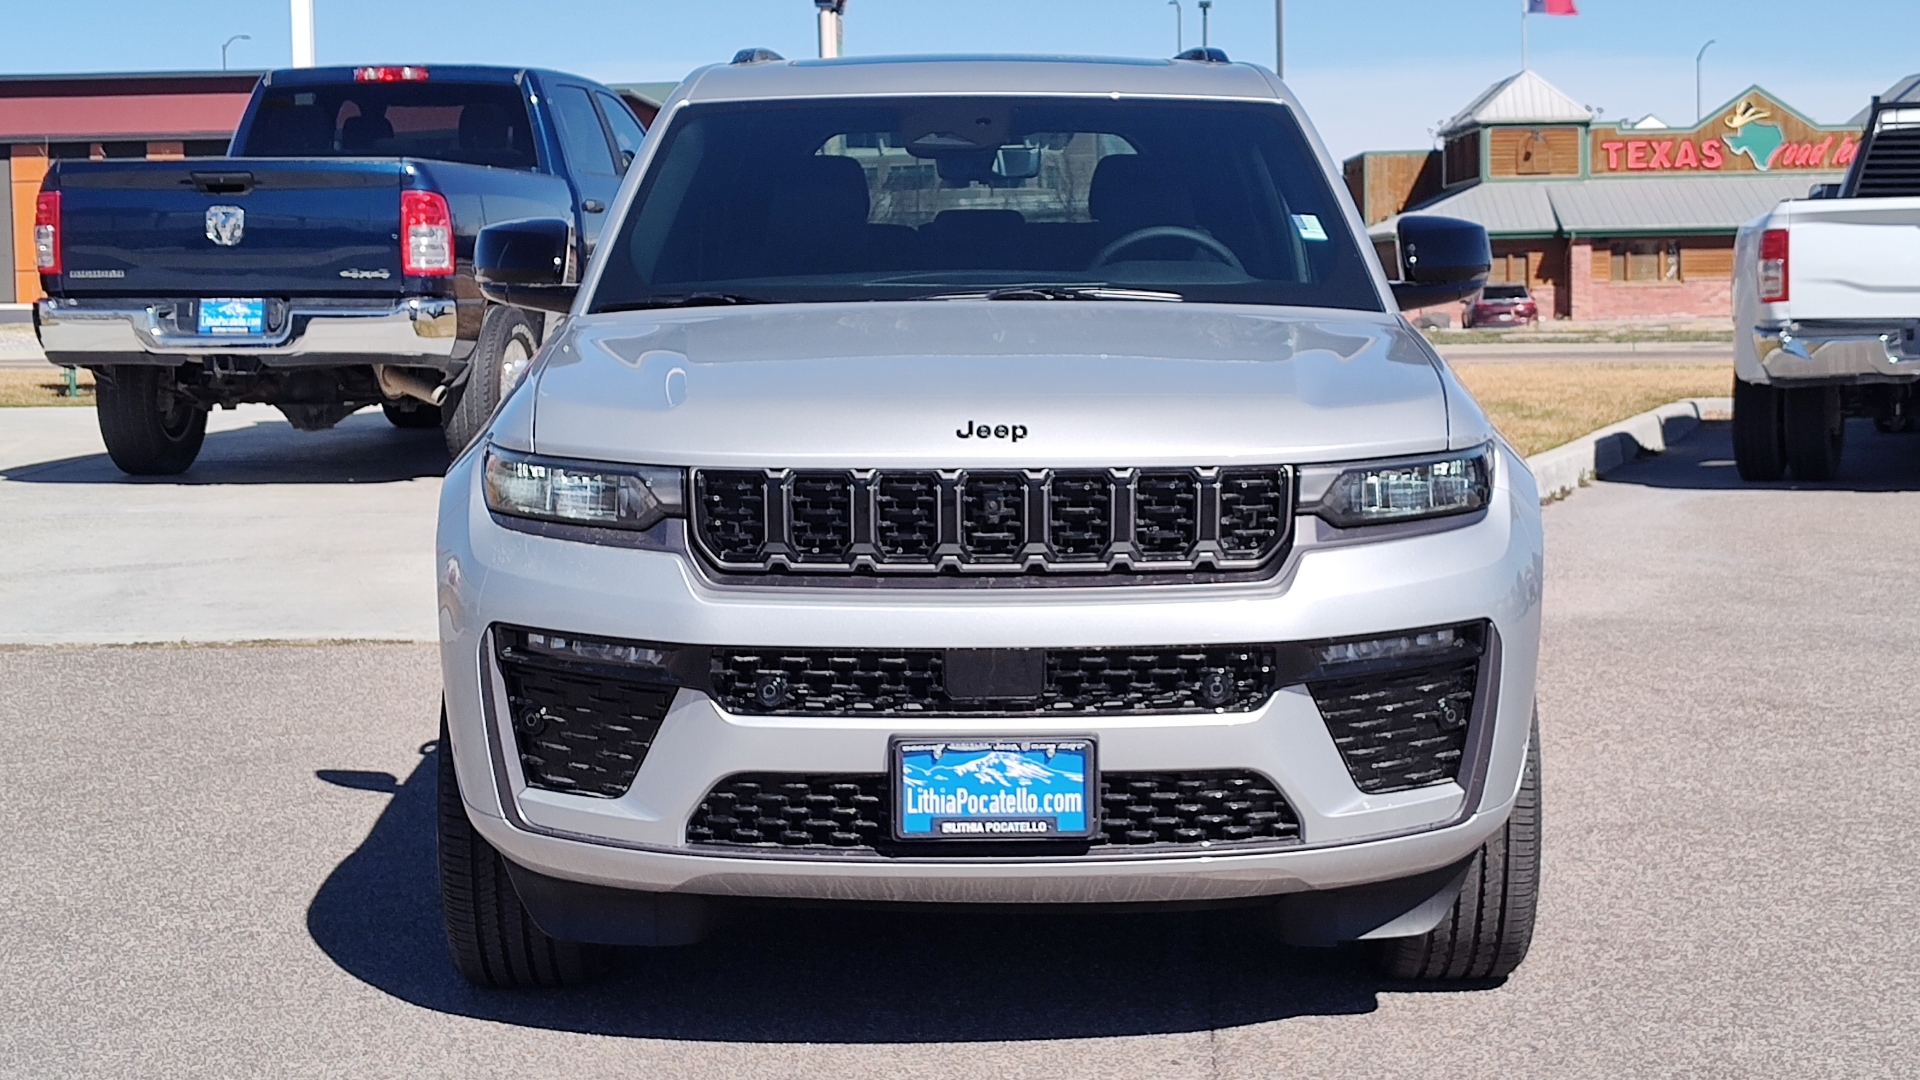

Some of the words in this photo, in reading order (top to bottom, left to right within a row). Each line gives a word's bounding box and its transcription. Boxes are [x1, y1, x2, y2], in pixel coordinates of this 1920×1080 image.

[1602, 138, 1725, 170] TEXAS
[956, 420, 1028, 442] Jeep
[906, 787, 1083, 814] LithiaPocatello.com
[985, 821, 1048, 833] POCATELLO
